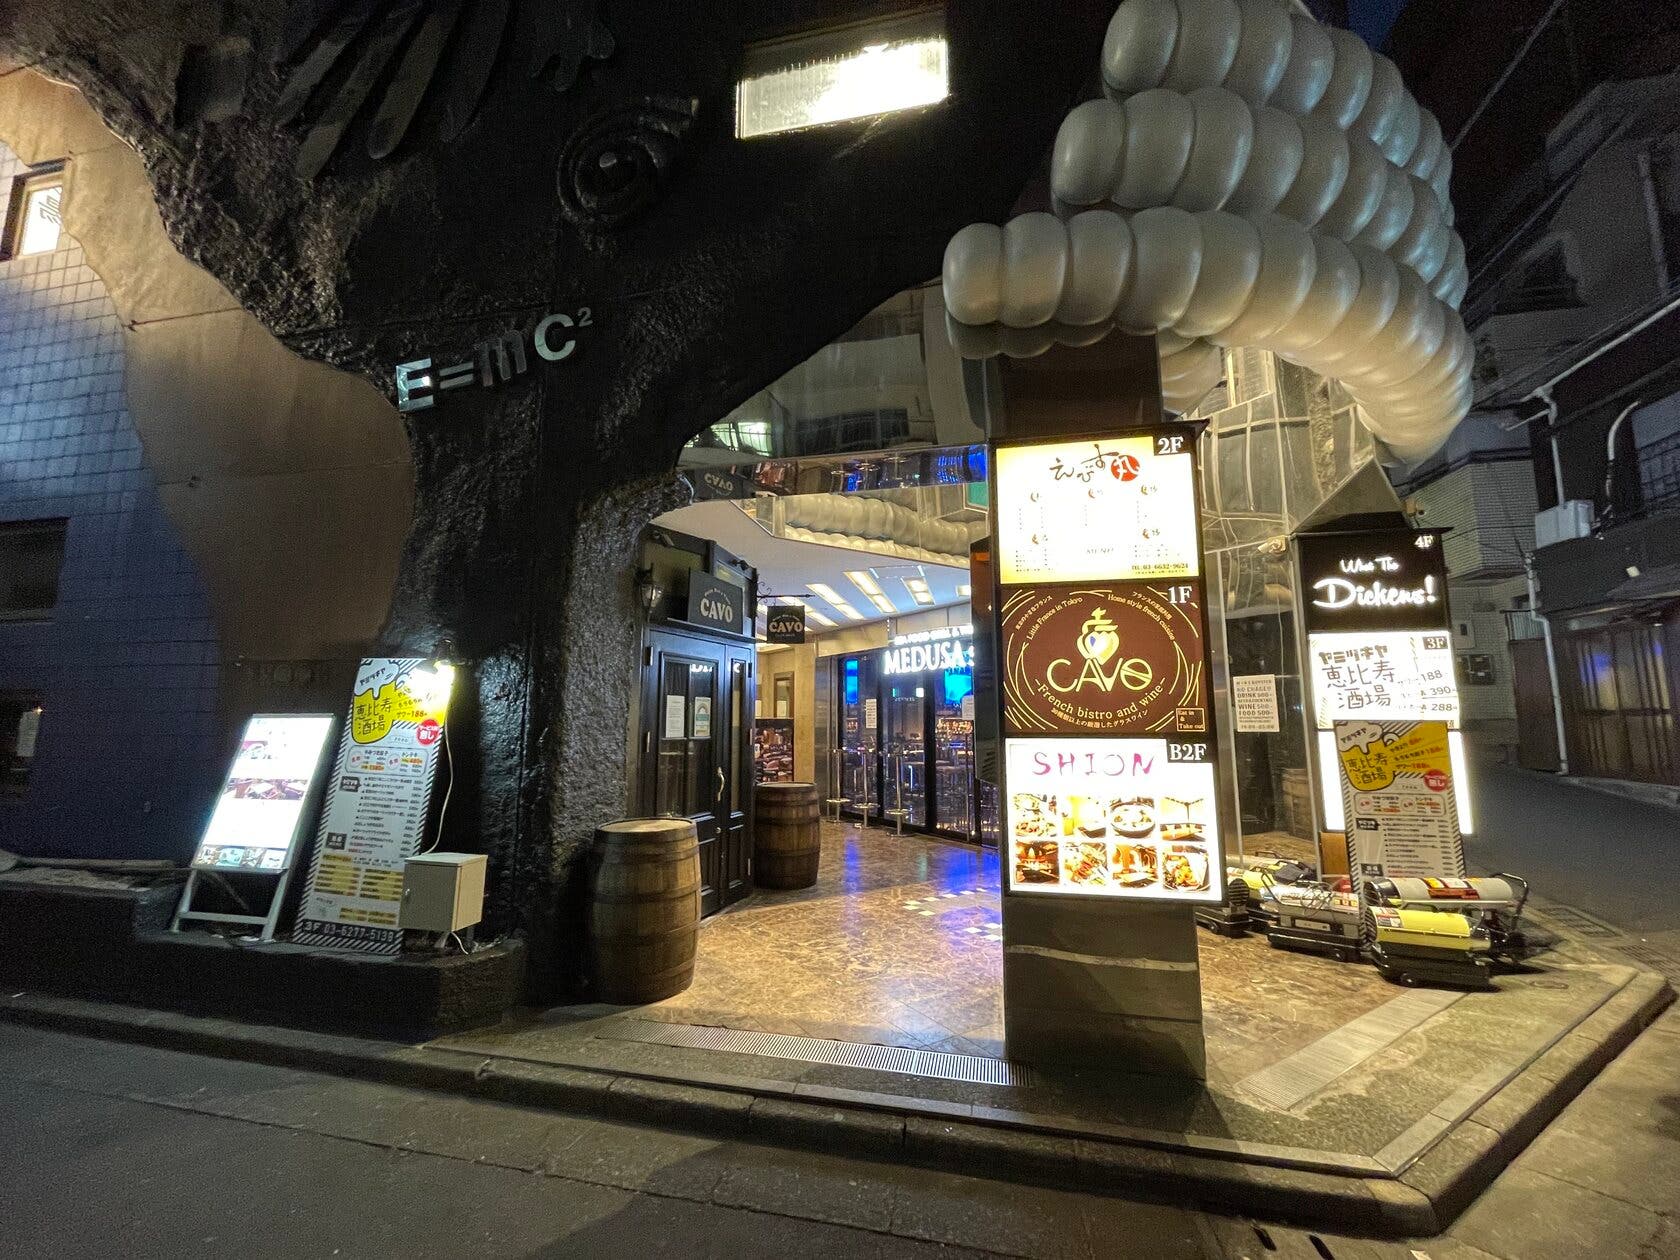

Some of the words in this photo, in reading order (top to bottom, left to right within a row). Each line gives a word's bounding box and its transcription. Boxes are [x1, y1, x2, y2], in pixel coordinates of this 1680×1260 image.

[1158, 436, 1184, 454] 2F
[1414, 535, 1434, 548] 4F
[1168, 586, 1192, 604] 1F
[1312, 574, 1437, 608] Dickens!
[700, 598, 733, 623] CAVO
[1036, 608, 1056, 625] France
[1061, 597, 1083, 607] Tokyo
[1107, 594, 1126, 604] Home
[1126, 600, 1142, 610] style
[1142, 605, 1160, 622] french
[1159, 619, 1175, 640] cuisine
[768, 621, 804, 633] CAVO
[1427, 638, 1445, 649] 3F
[883, 640, 967, 675] MEDUSA
[1046, 657, 1153, 692] CAVO
[1321, 659, 1396, 688] 恵比寿
[1337, 684, 1392, 710] 酒場
[1077, 706, 1114, 721] bistro
[1117, 702, 1139, 718] and
[1032, 752, 1155, 776] SHION
[1169, 743, 1208, 761] B2F
[305, 921, 321, 931] 3F
[324, 923, 395, 942] 03-6277-5138
